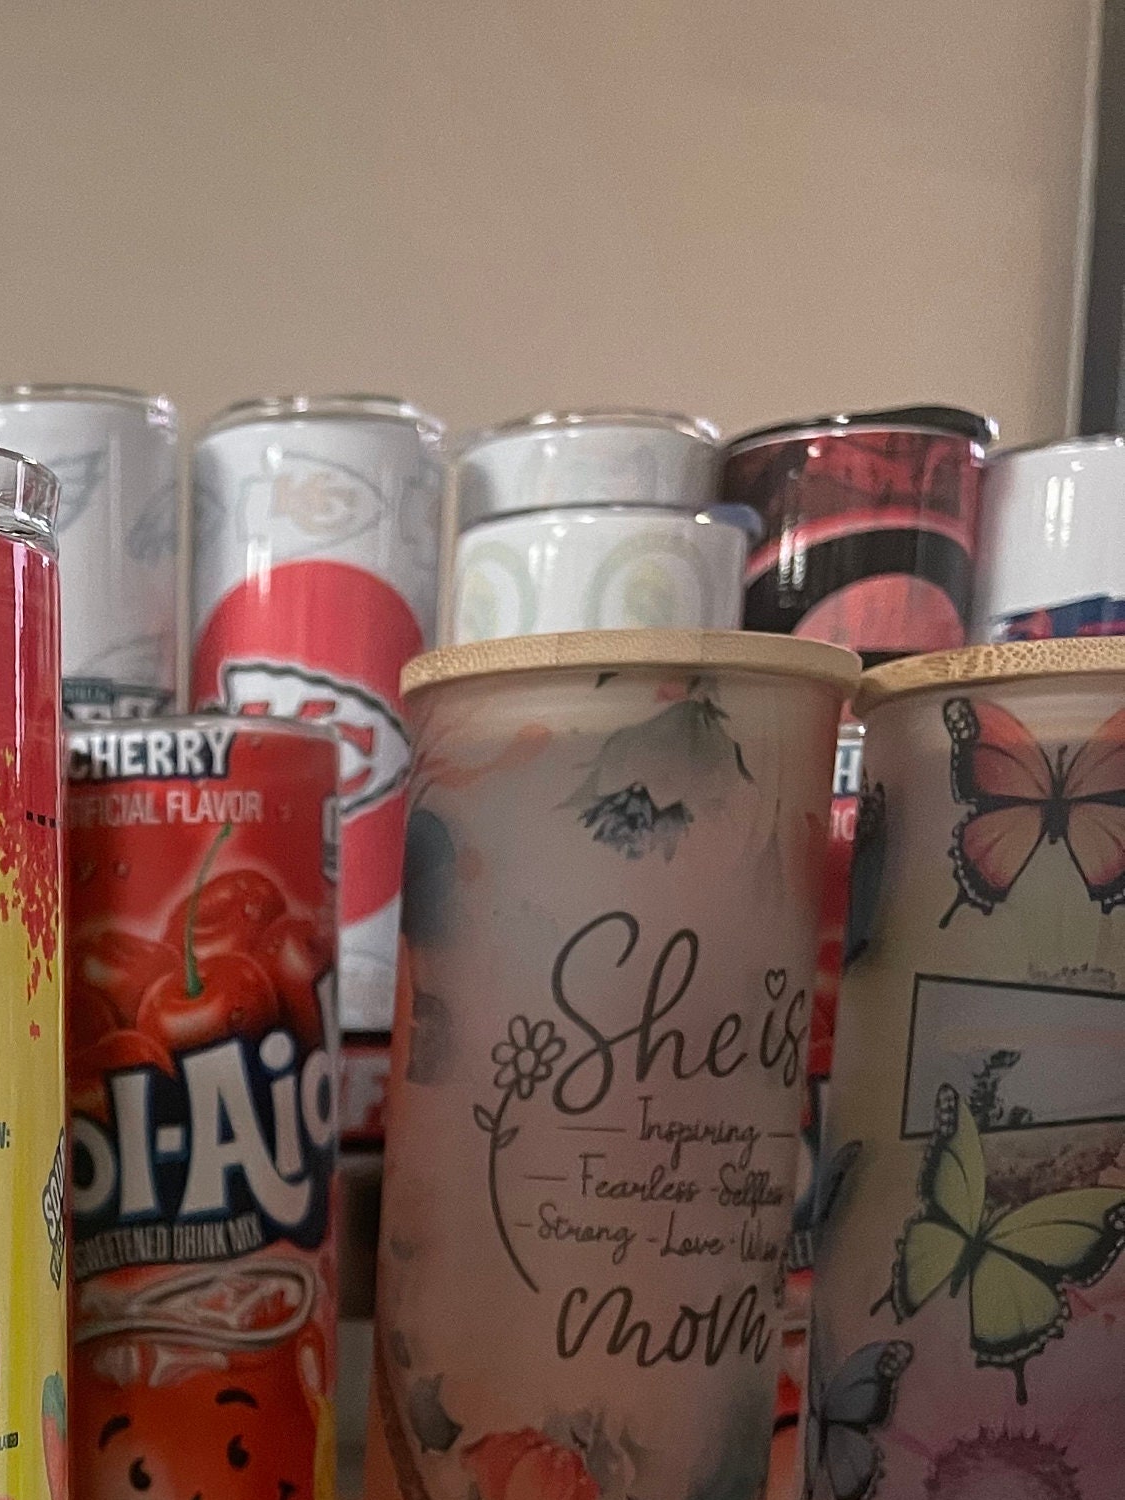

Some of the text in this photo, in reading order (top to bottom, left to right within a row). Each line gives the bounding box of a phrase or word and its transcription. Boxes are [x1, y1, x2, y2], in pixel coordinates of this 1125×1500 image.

[69, 728, 236, 783] CHERRY
[166, 789, 264, 824] FLAVOR
[552, 911, 748, 1115] She
